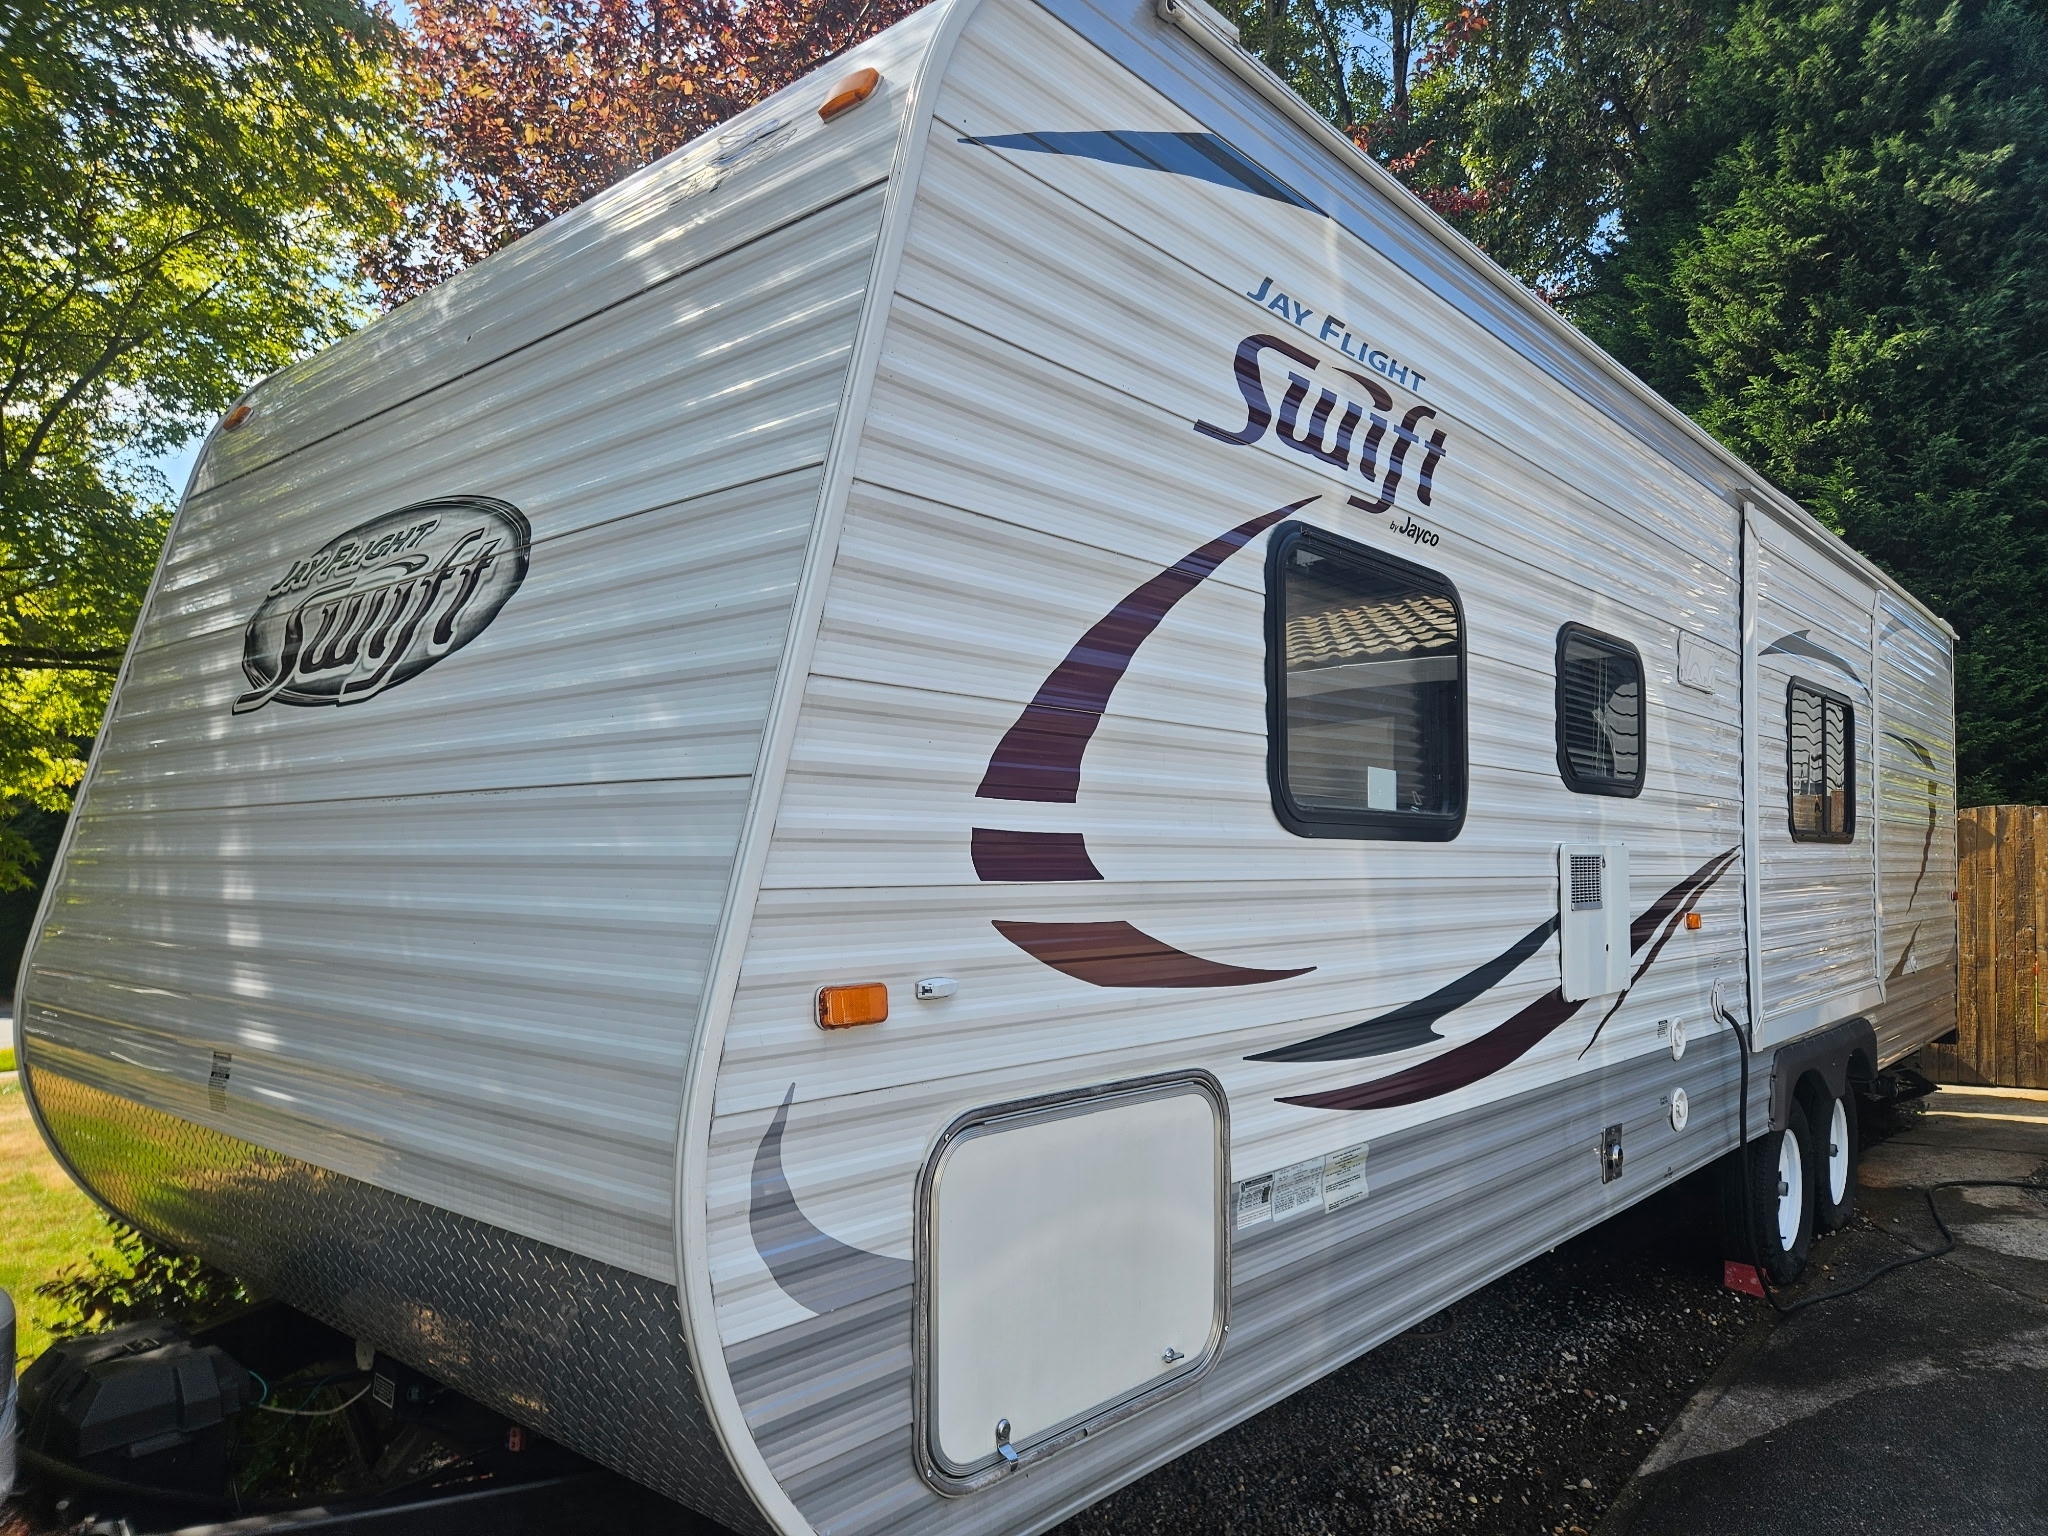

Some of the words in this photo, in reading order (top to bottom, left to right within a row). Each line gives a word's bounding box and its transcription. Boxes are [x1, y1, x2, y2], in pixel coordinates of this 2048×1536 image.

[1247, 276, 1313, 326] JAY
[1320, 315, 1426, 392] FLIGHT
[1193, 334, 1447, 514] Swift
[270, 556, 330, 591] JAY
[320, 519, 438, 577] FLIGHT
[1389, 520, 1399, 533] by
[1399, 516, 1440, 547] Jayco
[234, 527, 502, 709] Swift
